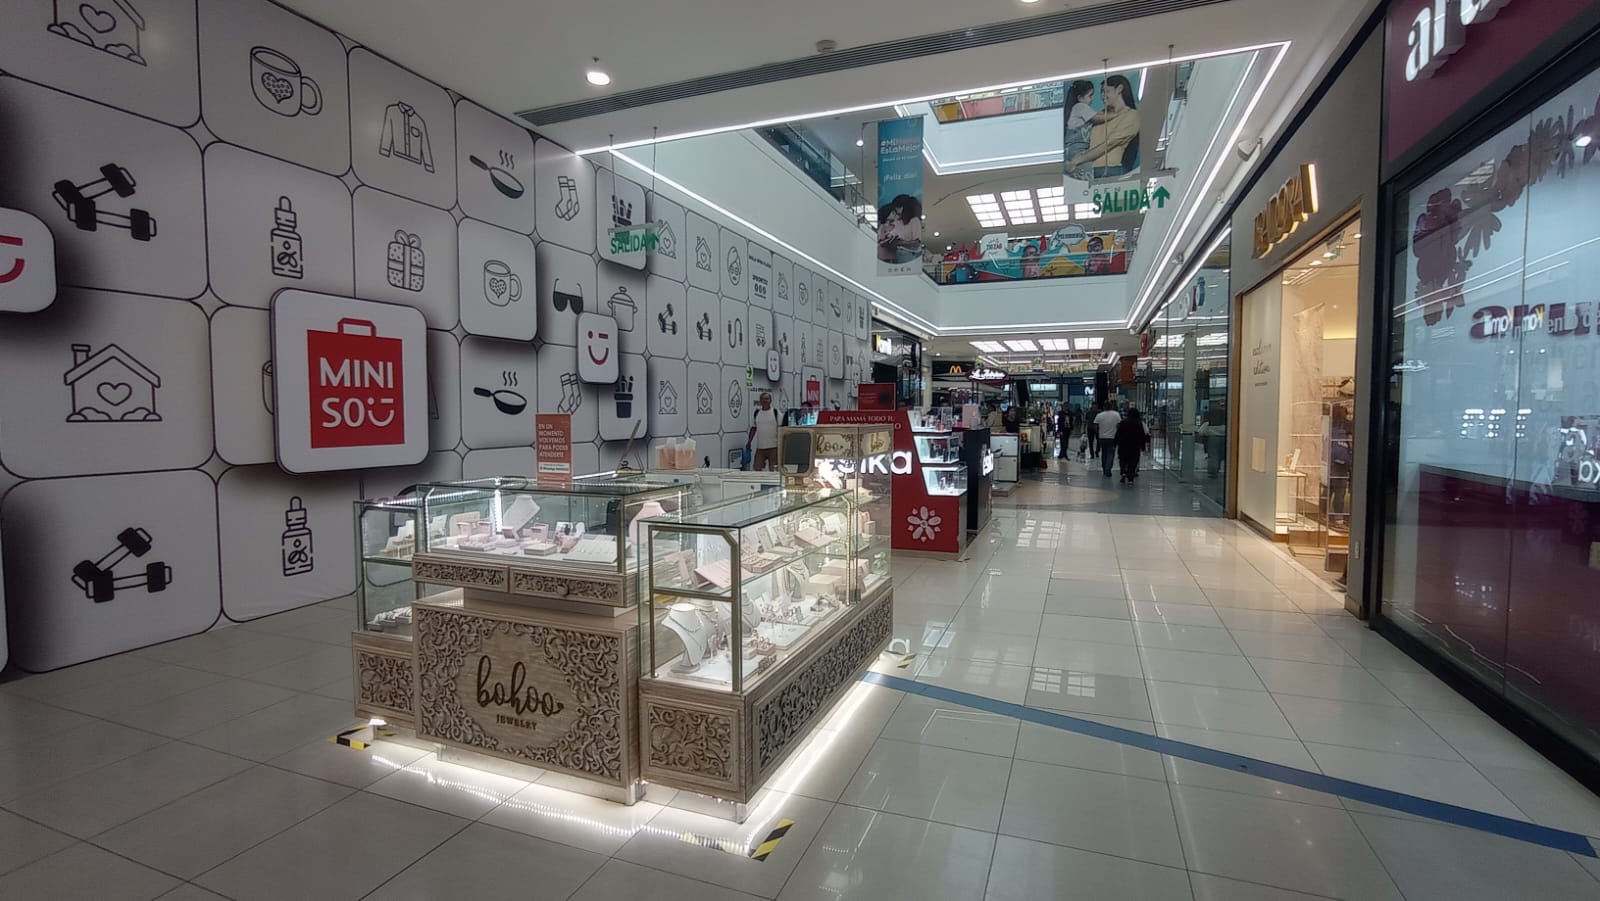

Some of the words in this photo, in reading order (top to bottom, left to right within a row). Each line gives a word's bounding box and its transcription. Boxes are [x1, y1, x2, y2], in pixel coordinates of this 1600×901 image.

[1093, 187, 1150, 214] SALIDA
[611, 233, 649, 254] SALIDA
[320, 356, 394, 388] MINI
[477, 655, 564, 717] bohoo
[496, 714, 537, 730] JEWELRY
